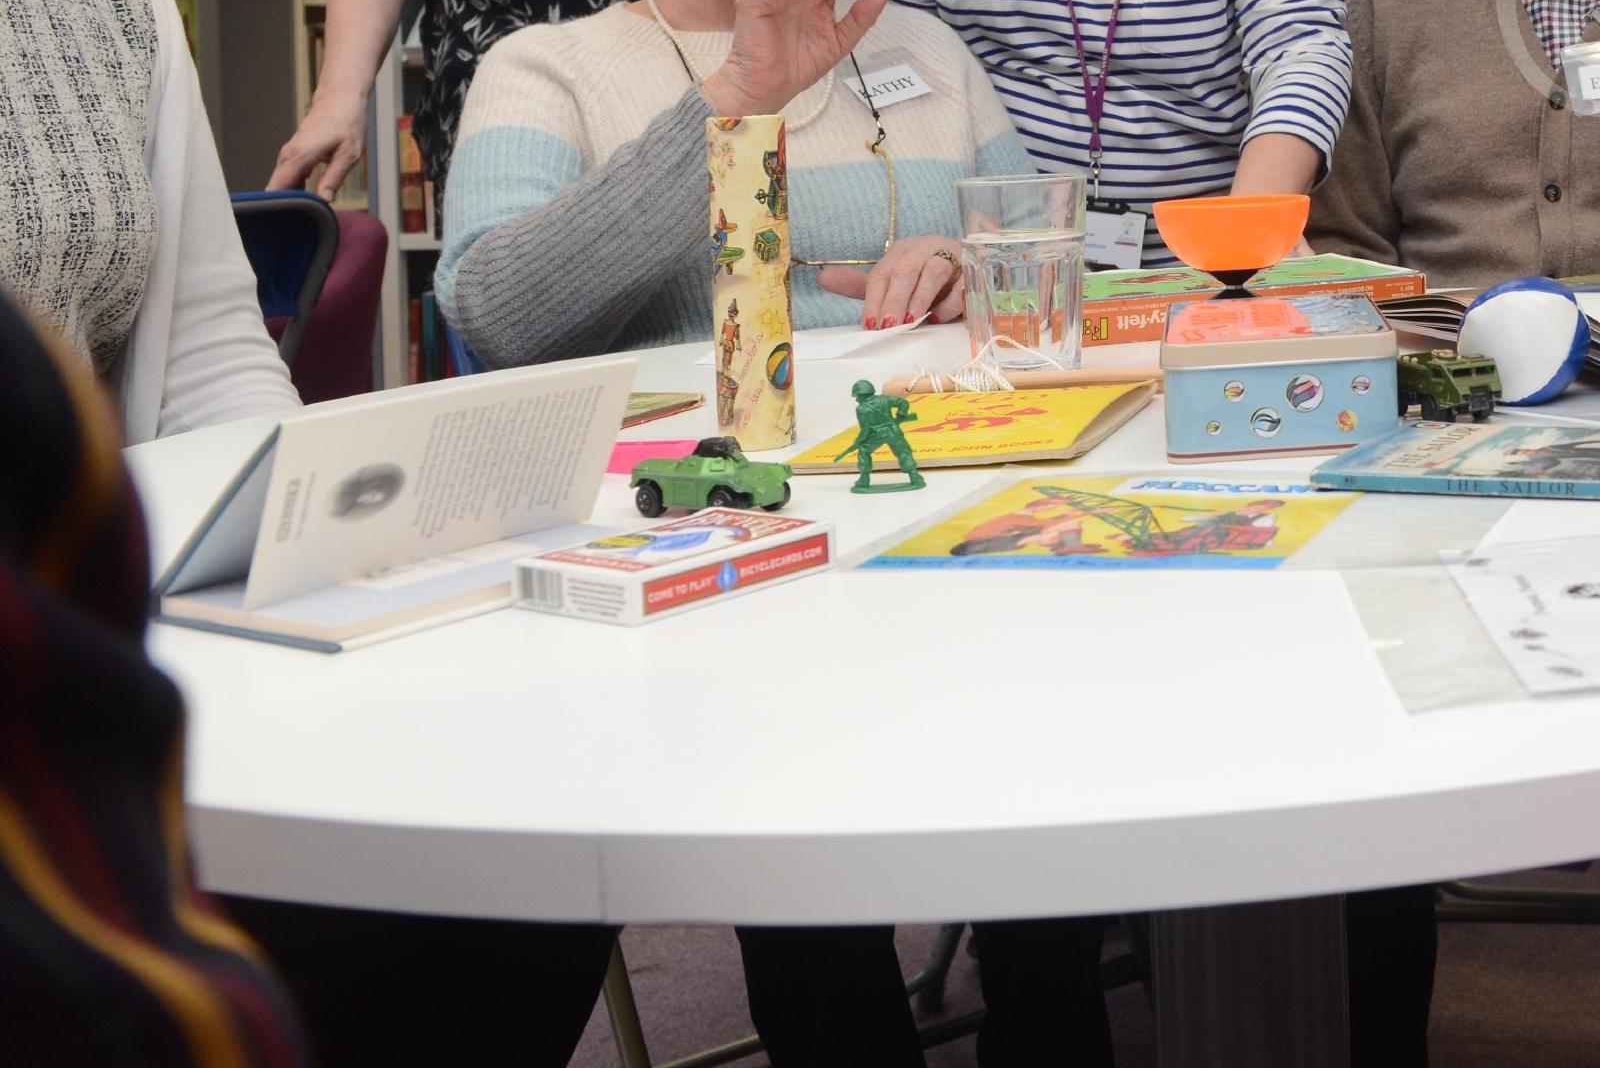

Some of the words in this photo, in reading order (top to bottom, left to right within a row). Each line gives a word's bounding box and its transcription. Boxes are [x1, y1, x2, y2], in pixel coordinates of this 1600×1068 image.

[858, 76, 916, 99] KATHY
[949, 443, 993, 453] JOHN
[998, 439, 1055, 449] BOOKS
[1383, 451, 1432, 468] THE
[1416, 426, 1481, 452] SAILOR
[1130, 479, 1314, 494] MECCAN
[1445, 478, 1485, 492] THE
[1500, 481, 1577, 495] SAILOR
[647, 587, 674, 604] COME
[675, 583, 688, 595] TO
[739, 544, 823, 579] BICYCLECARDS.COM
